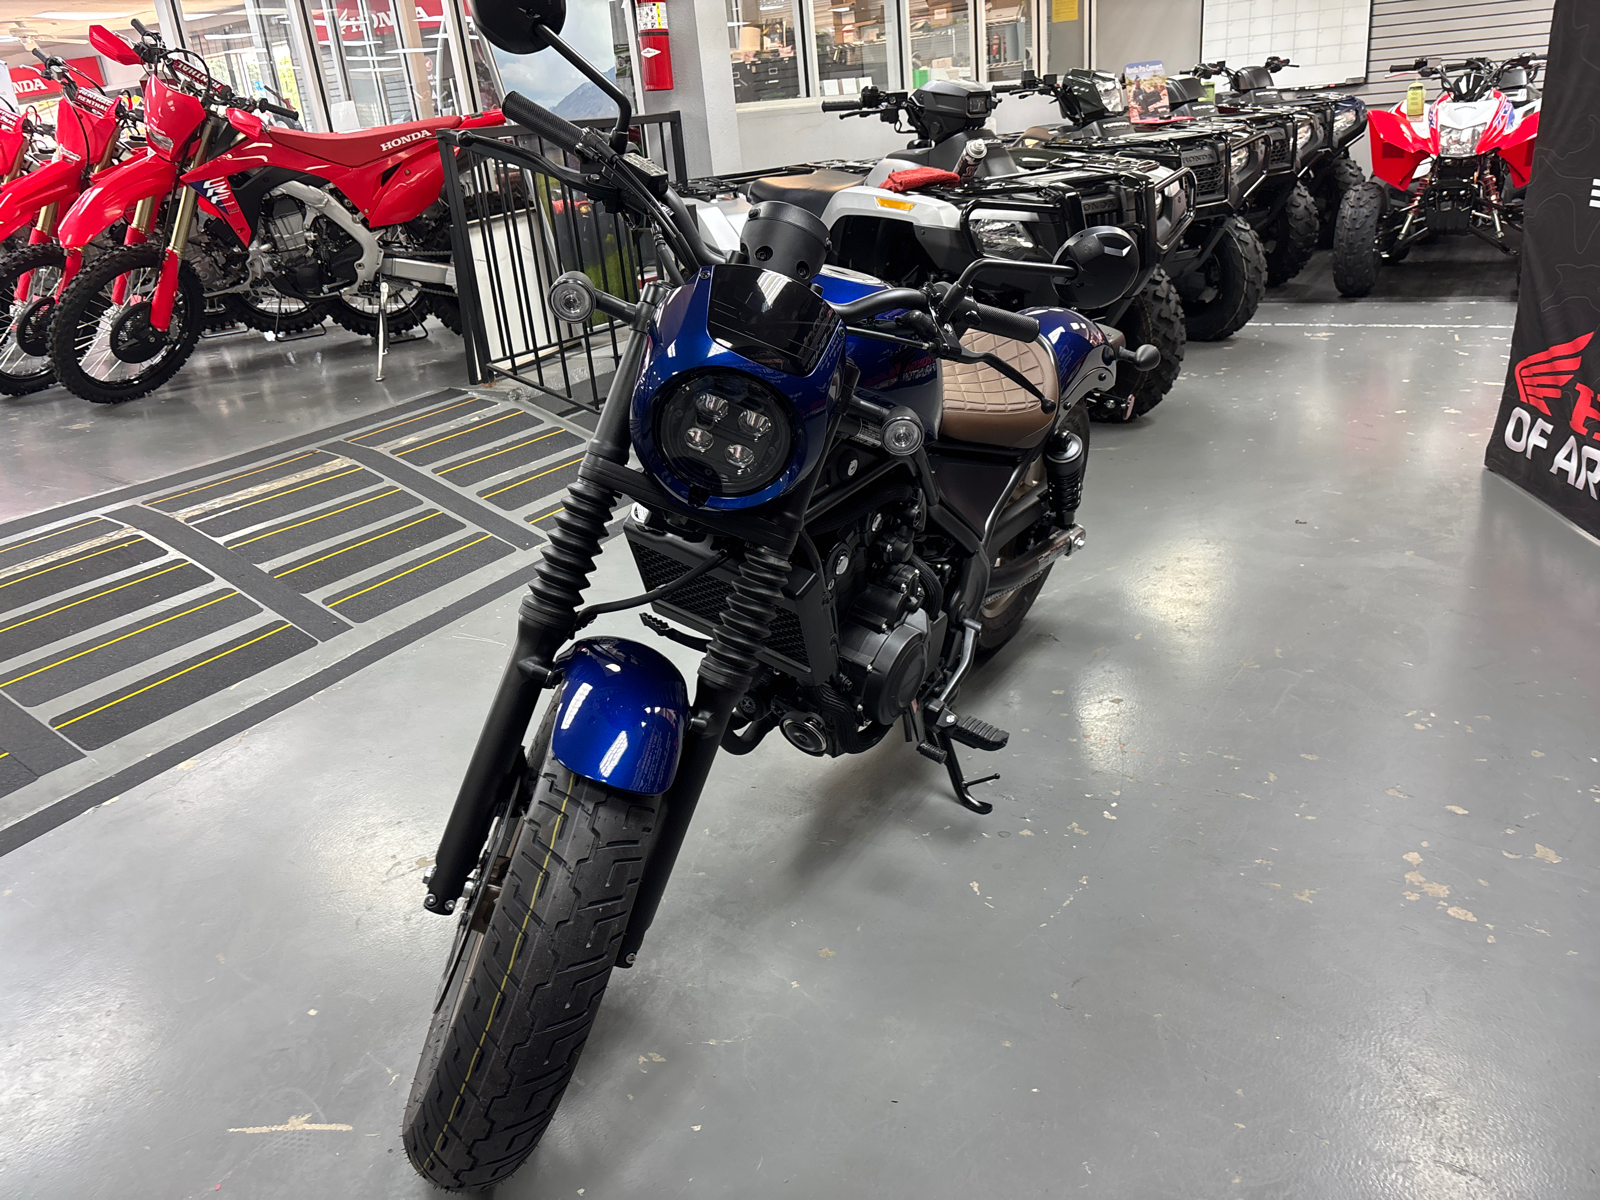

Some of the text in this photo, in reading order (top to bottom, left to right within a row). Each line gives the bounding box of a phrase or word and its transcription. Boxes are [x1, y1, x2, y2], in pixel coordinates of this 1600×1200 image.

[12, 78, 48, 94] NDA
[177, 61, 221, 89] RNTHAL
[380, 129, 432, 151] HONDA
[1182, 153, 1214, 164] HONDA
[203, 176, 231, 205] CRF
[1083, 201, 1117, 212] ONDA
[1504, 406, 1554, 460] OF
